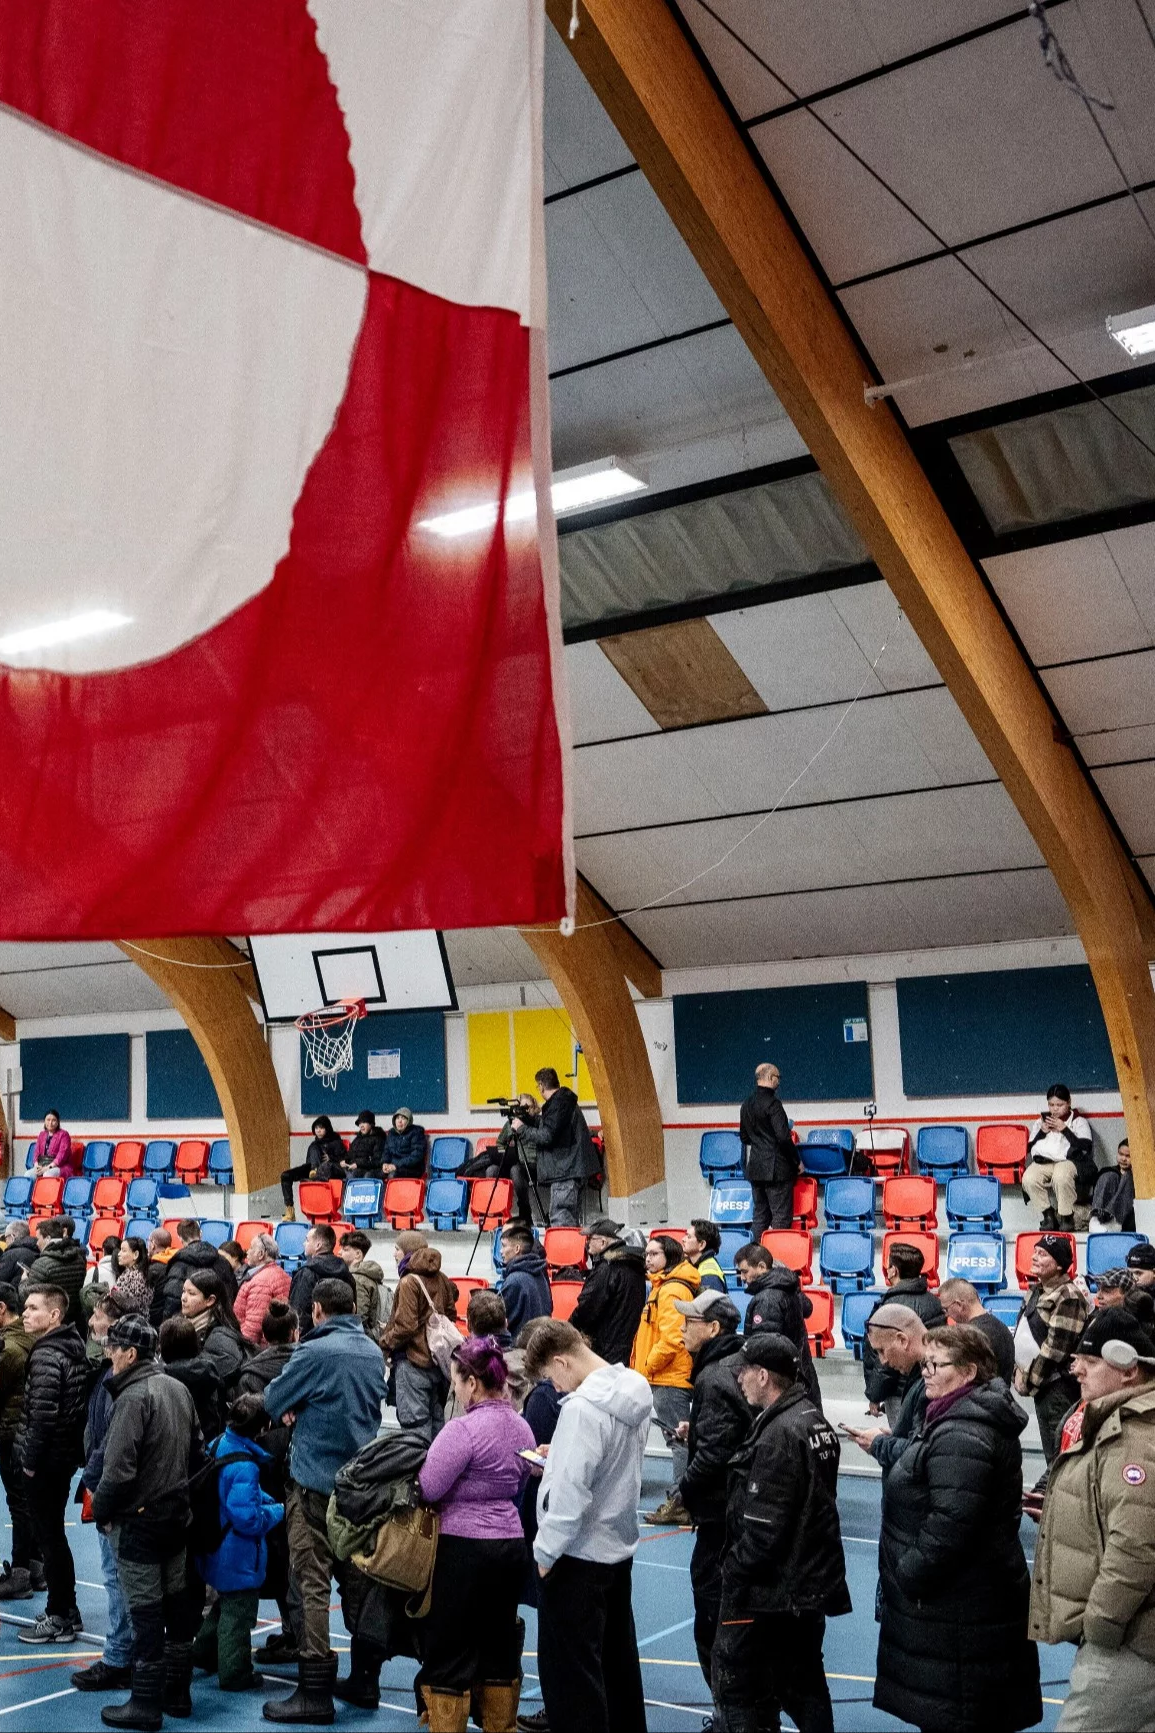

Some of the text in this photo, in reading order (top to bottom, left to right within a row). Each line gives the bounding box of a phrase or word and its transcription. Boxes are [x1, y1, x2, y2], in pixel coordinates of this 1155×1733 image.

[350, 1195, 375, 1203] PRESS
[716, 1201, 751, 1210] PRESS
[954, 1257, 996, 1267] PRESS
